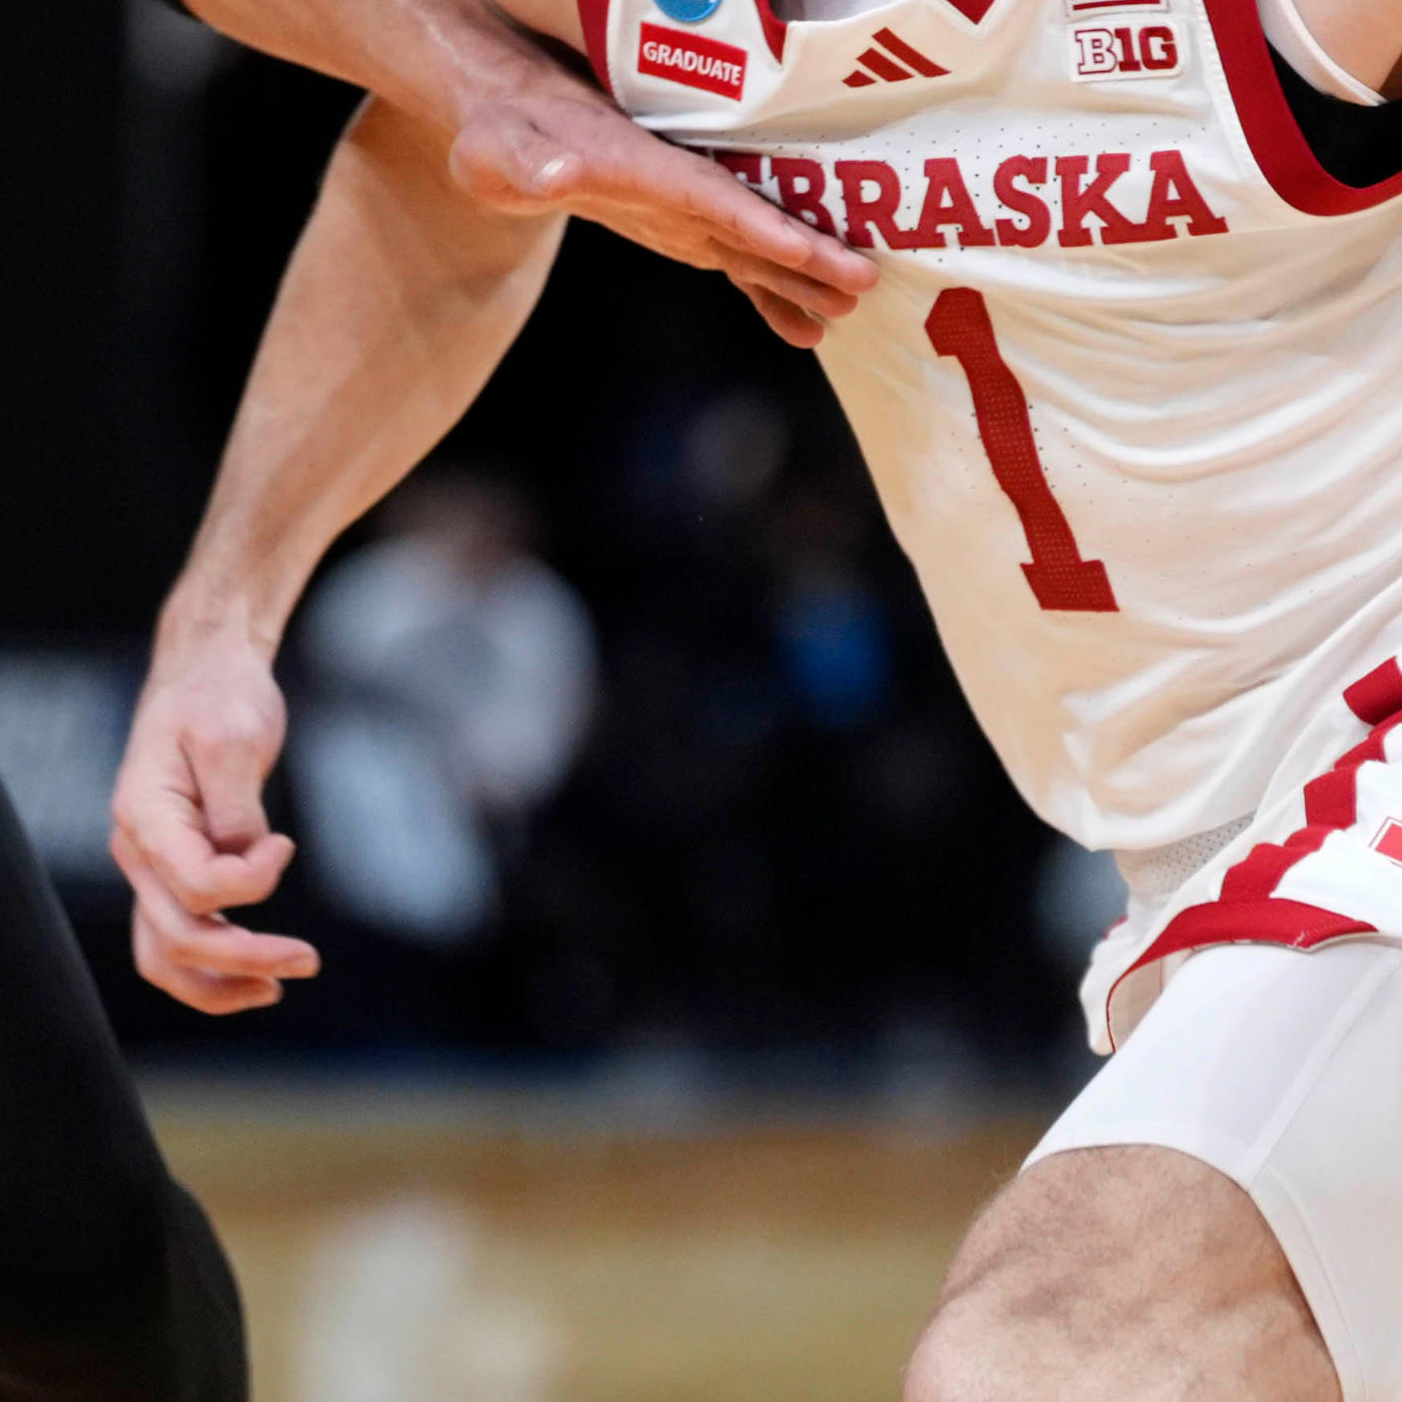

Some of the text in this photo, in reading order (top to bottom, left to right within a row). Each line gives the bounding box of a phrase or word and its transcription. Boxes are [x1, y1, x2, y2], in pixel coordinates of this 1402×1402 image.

[641, 40, 743, 87] GRADUATE
[688, 146, 1229, 251] BRASKA
[923, 285, 1121, 613] 1
